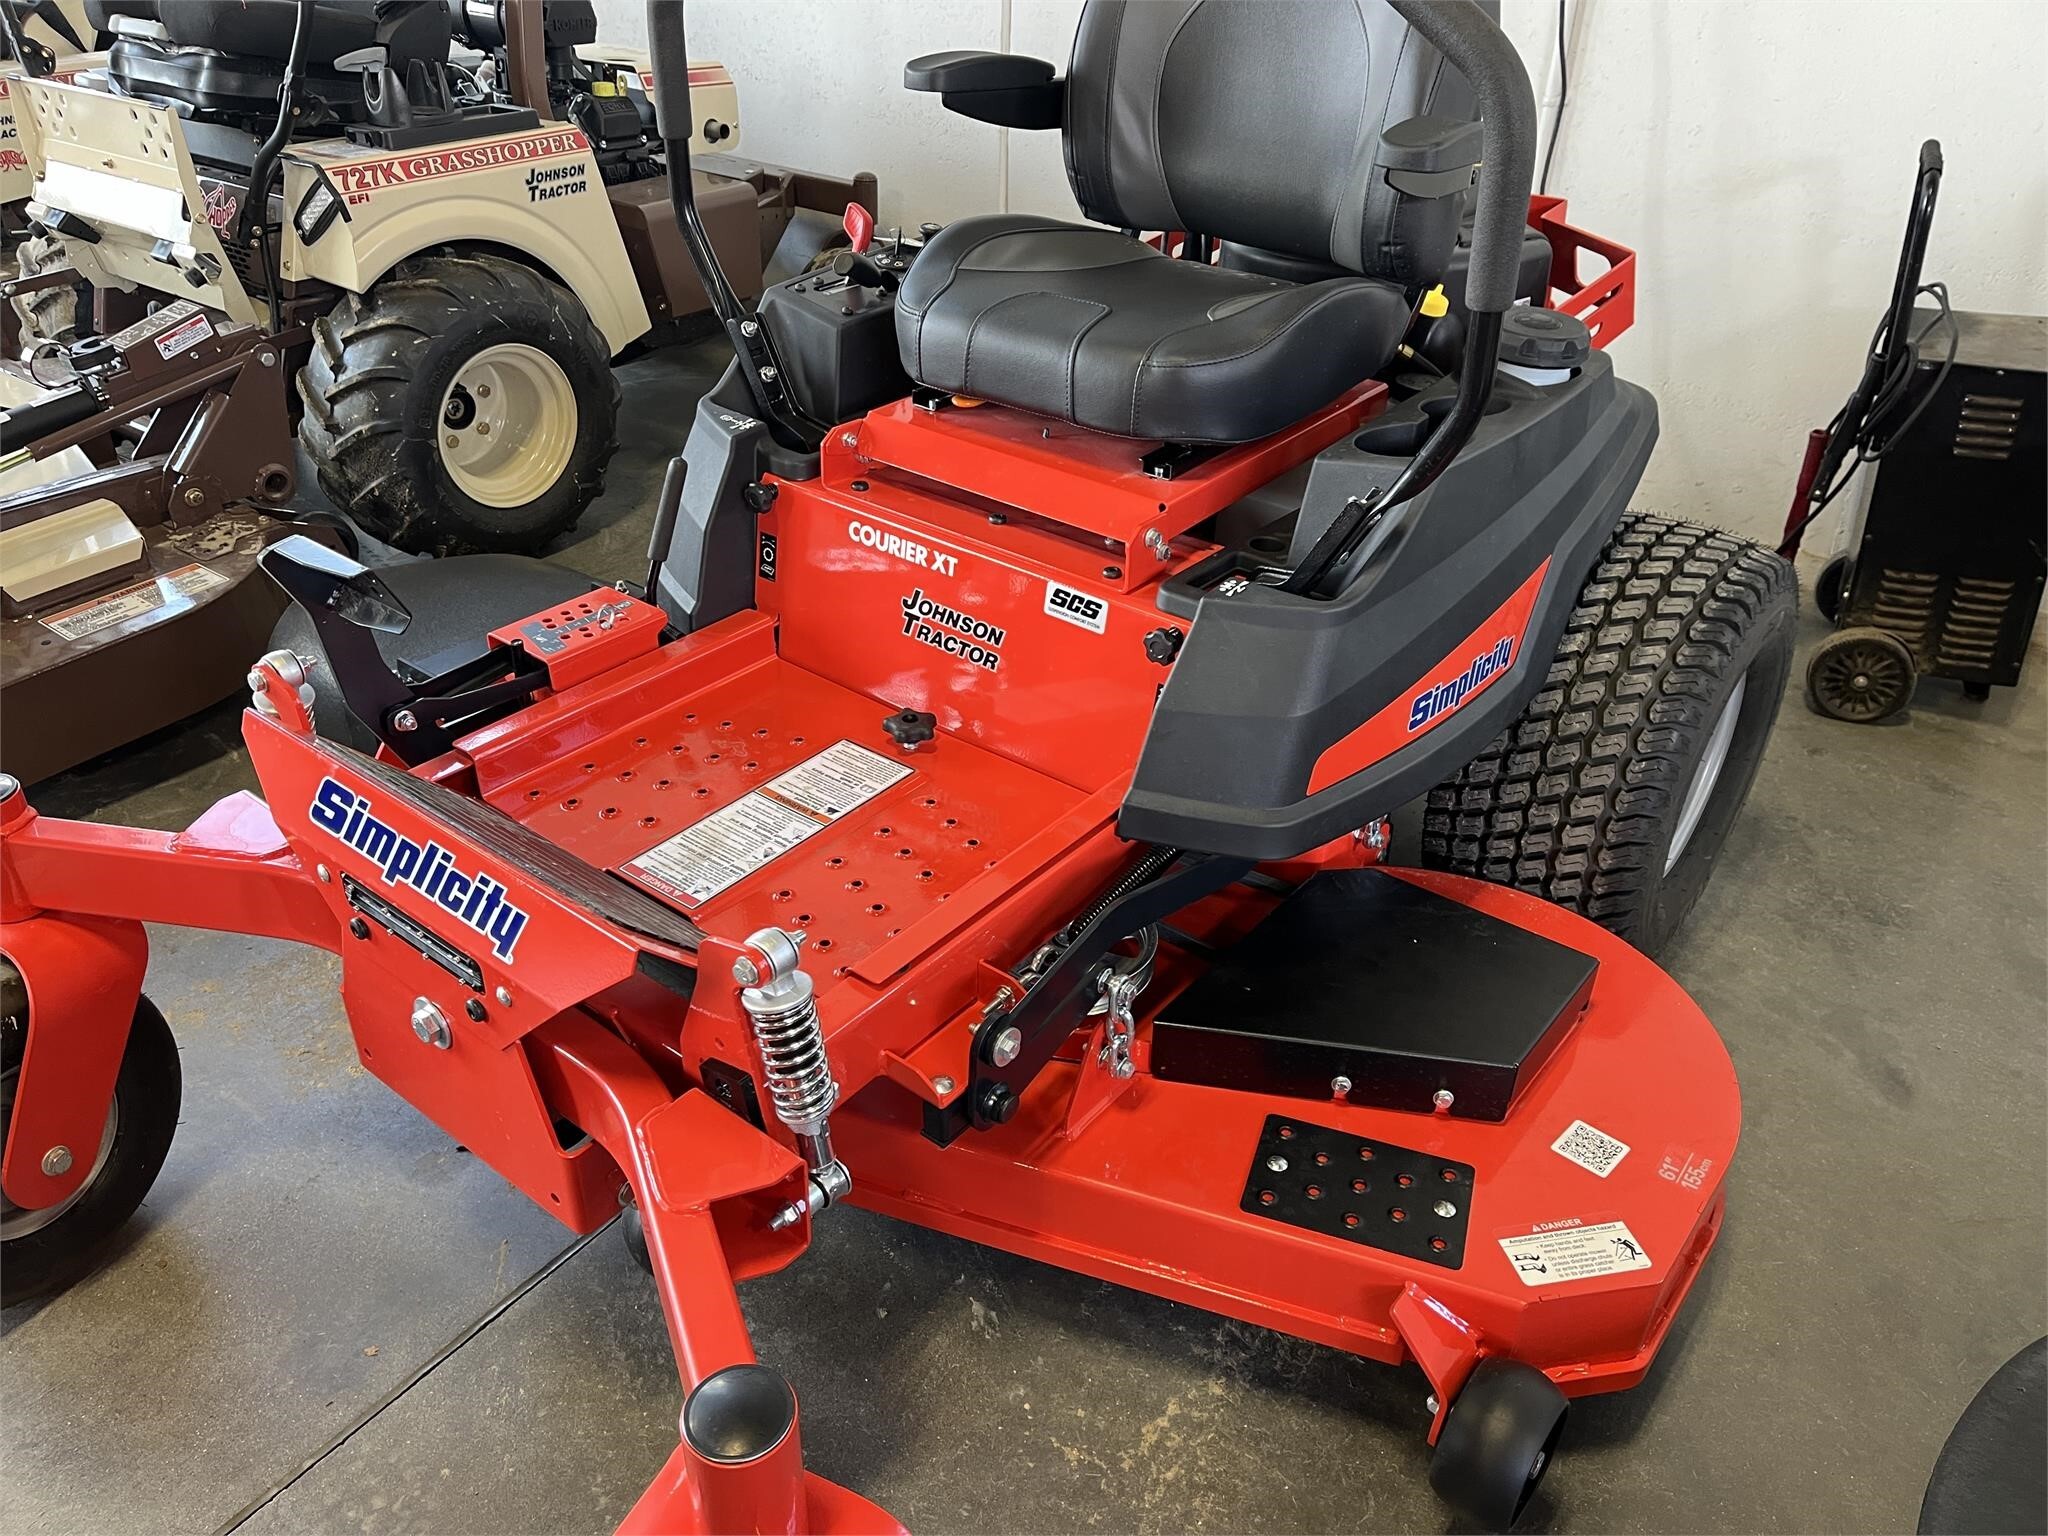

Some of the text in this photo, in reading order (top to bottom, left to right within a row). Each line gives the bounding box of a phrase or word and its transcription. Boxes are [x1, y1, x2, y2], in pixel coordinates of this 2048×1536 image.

[332, 161, 405, 191] 727K
[408, 133, 578, 178] GRASSHOPPER
[525, 164, 586, 186] JOHNSON
[349, 192, 370, 205] EFI
[528, 180, 588, 202] TRACTOR
[848, 521, 959, 577] COURIER XT
[902, 589, 1005, 646] JOHNSON
[1050, 588, 1102, 620] SCS
[903, 610, 999, 670] TRACTOR
[1409, 635, 1514, 731] Simplicity
[773, 794, 810, 813] WARNING
[310, 777, 528, 959] Simplicity
[639, 872, 674, 892] DANGER
[1541, 1218, 1583, 1231] DANGER
